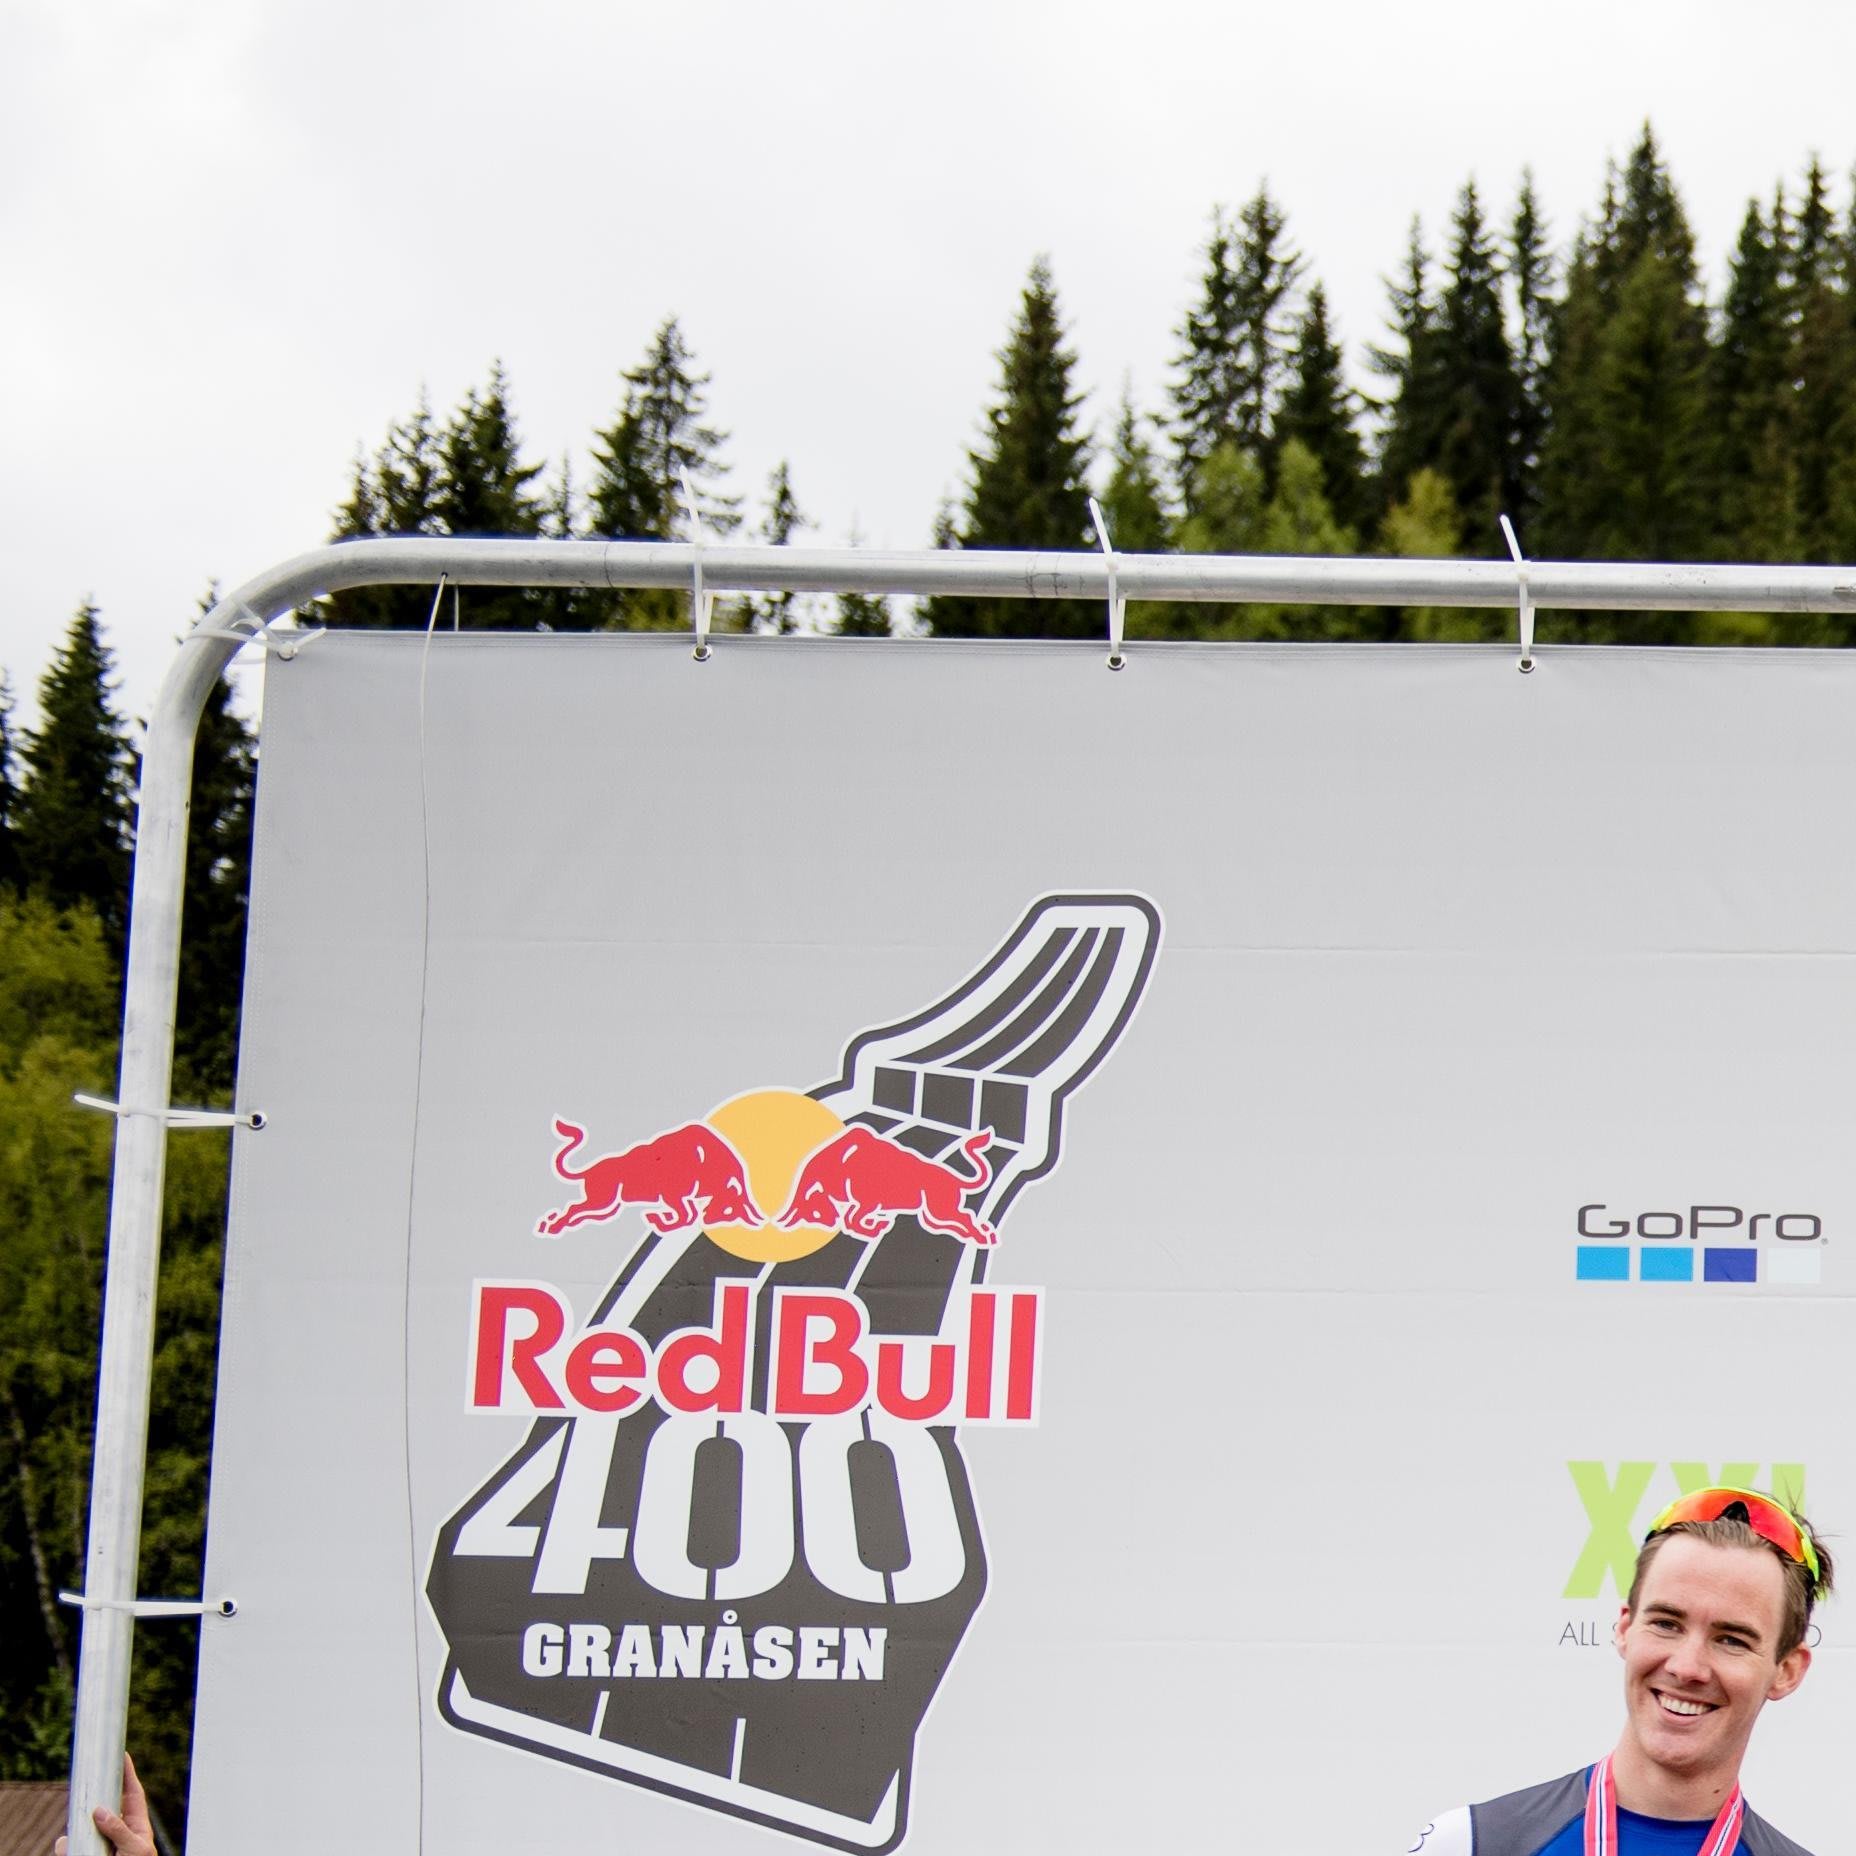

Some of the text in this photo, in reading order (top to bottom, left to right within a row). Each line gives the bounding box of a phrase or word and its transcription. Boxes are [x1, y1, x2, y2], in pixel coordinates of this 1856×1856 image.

[1577, 1204, 1822, 1241] GoPro
[473, 1286, 1037, 1421] Red Bull
[453, 1416, 967, 1603] 400
[521, 1611, 888, 1680] GRANÅSEN
[1559, 1621, 1600, 1646] ALL
